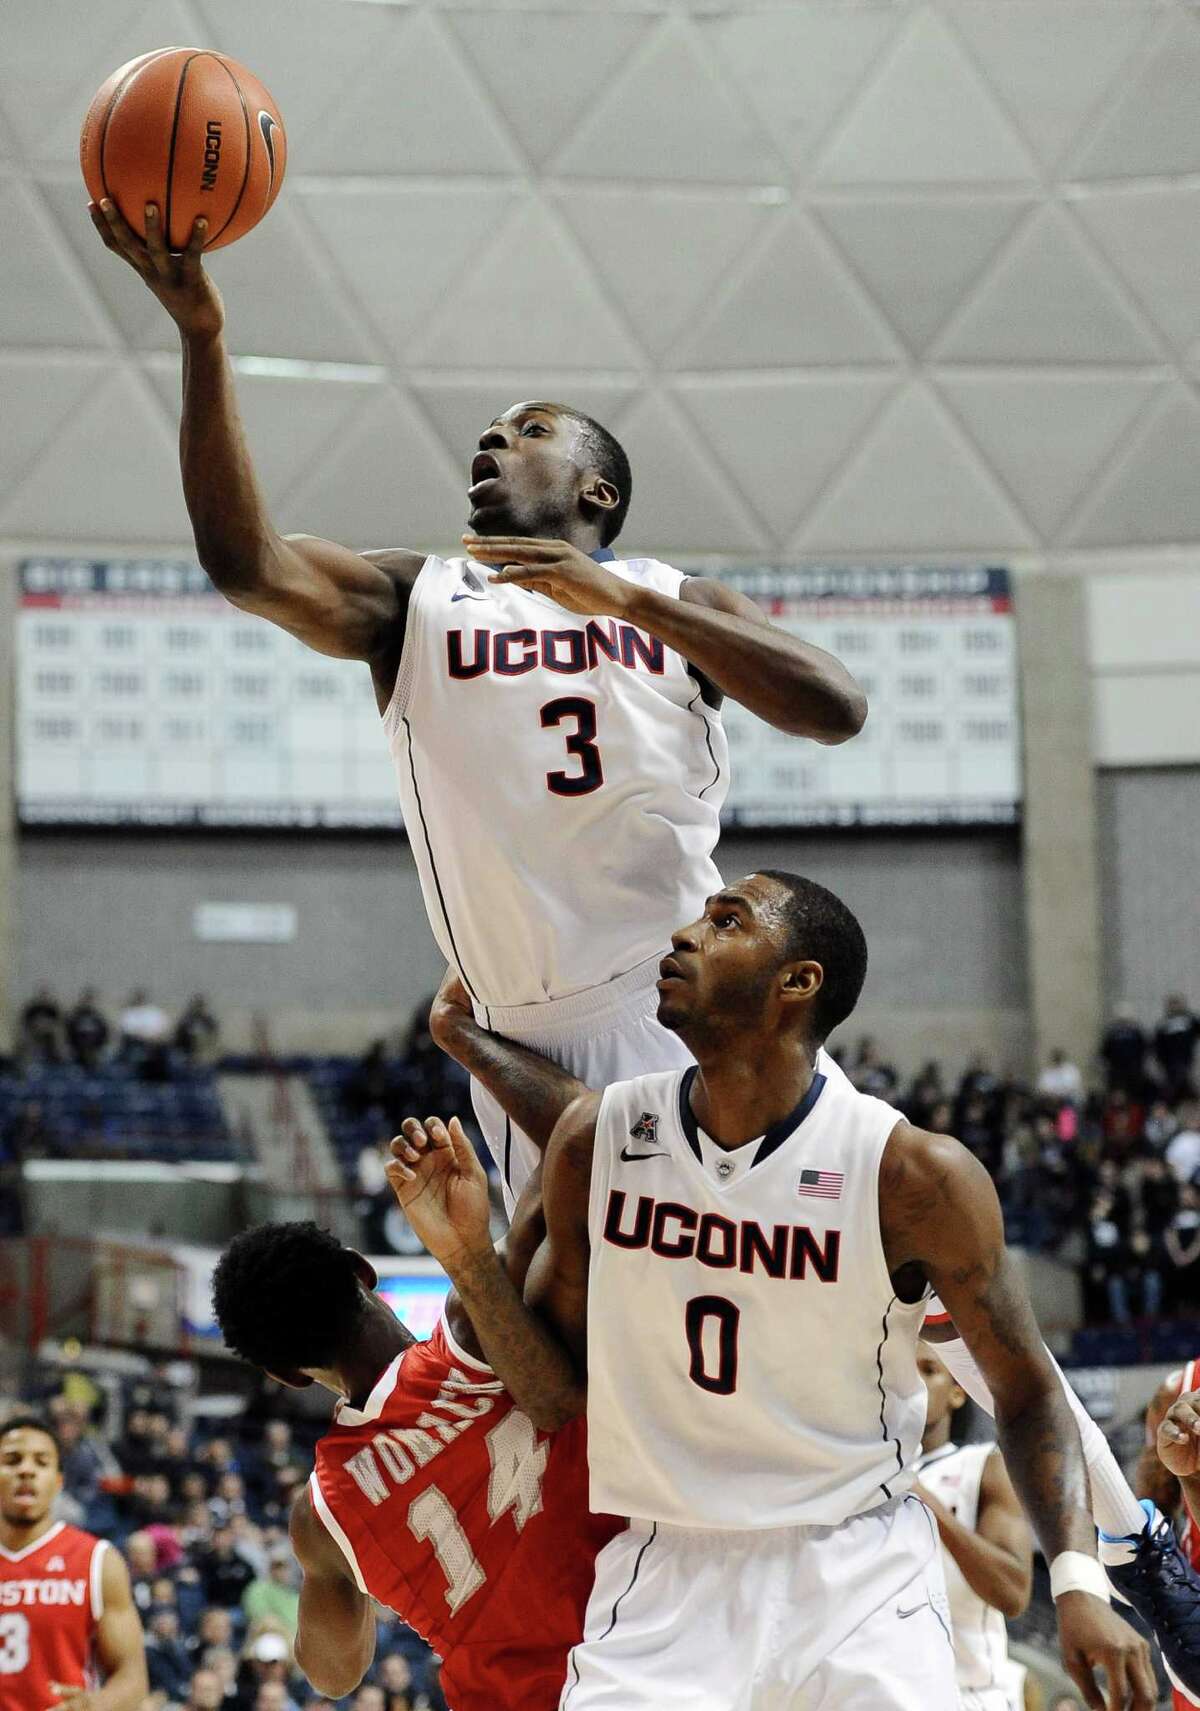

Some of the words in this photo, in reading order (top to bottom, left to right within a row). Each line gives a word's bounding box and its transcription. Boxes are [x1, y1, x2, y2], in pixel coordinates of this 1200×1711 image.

[201, 120, 222, 191] UCONN
[446, 618, 665, 680] UCONN
[539, 696, 604, 797] 3
[603, 1189, 841, 1283] UCONN
[685, 1294, 741, 1396] 0
[406, 1403, 551, 1619] 14
[0, 1578, 87, 1606] STON
